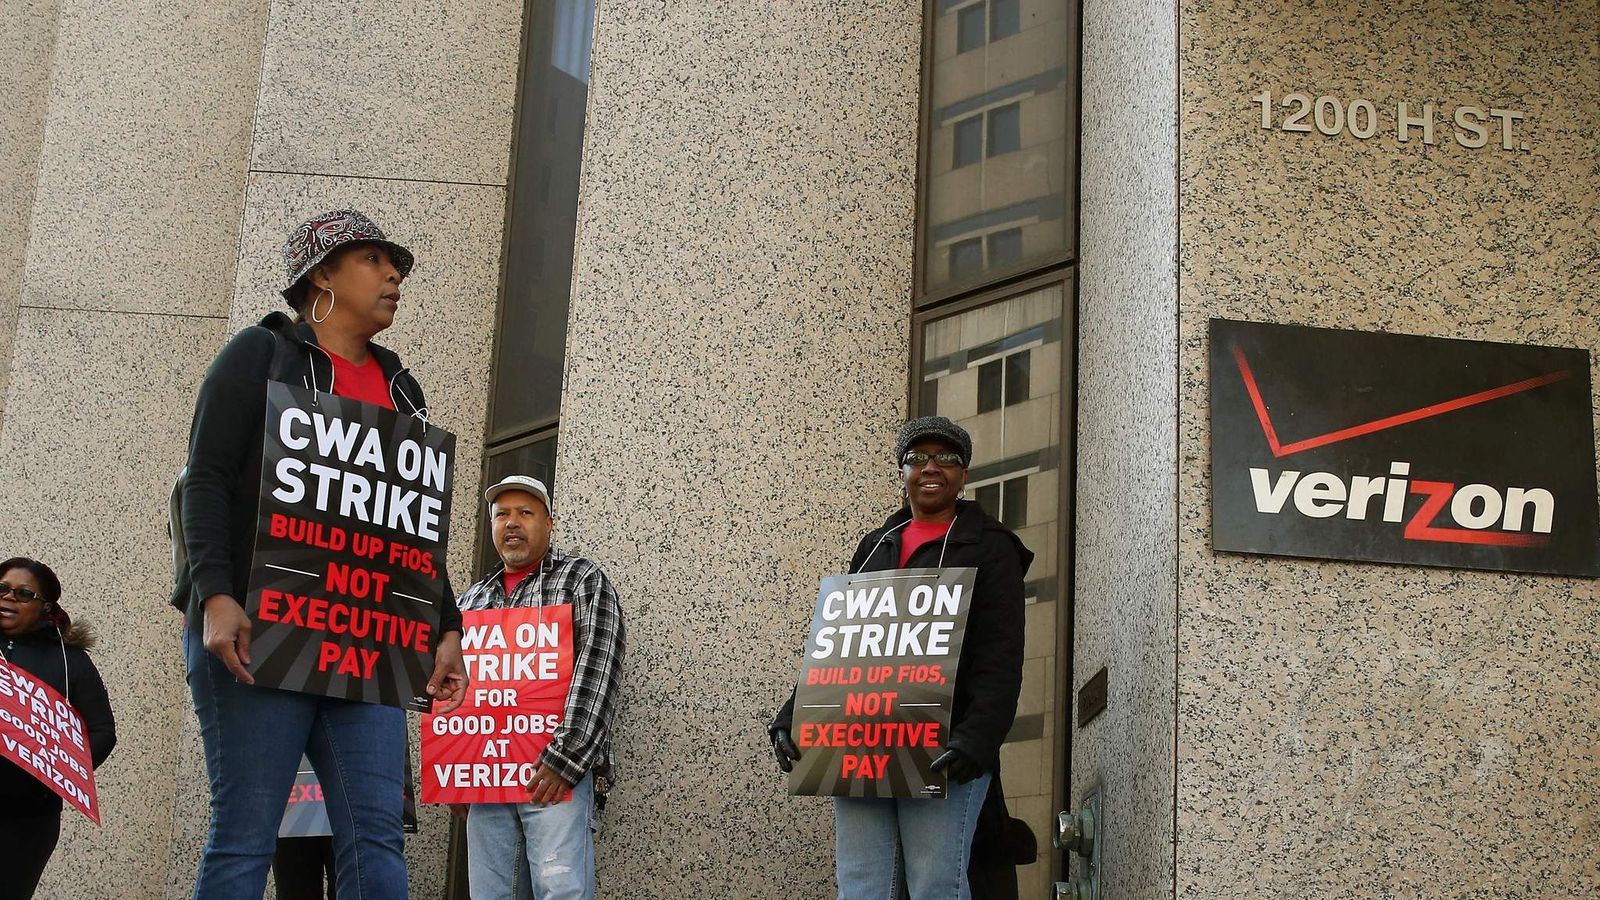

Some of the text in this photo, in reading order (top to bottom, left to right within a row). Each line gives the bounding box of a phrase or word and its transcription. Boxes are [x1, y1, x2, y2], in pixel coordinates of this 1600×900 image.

[1252, 90, 1530, 150] 1200 H ST.
[279, 407, 447, 492] CWA ON
[271, 457, 442, 542] STRIKE
[1249, 461, 1555, 547] verizon
[270, 513, 437, 580] BUILD UP FiOS,
[325, 561, 390, 602] NOT
[257, 589, 432, 653] EXECUTIVE
[822, 584, 963, 621] CWA ON
[461, 622, 559, 650] WA ON
[811, 621, 954, 660] STRIKE
[318, 641, 380, 680] PAY
[462, 653, 559, 681] TRIKE
[806, 664, 946, 686] BUILD UP FiOS,
[0, 664, 82, 734] CWA ON
[0, 679, 85, 751] STRIKE
[474, 689, 518, 707] FOR
[844, 692, 898, 716] NOT
[30, 713, 61, 744] FOR
[432, 714, 559, 735] GOOD JOBS
[799, 721, 941, 748] EXECUTIVE
[0, 708, 89, 781] GOOD JOBS
[38, 747, 58, 767] AT
[482, 739, 510, 758] AT
[1, 733, 91, 810] VERIZON
[434, 763, 537, 788] VERIZO
[841, 754, 891, 779] PAY
